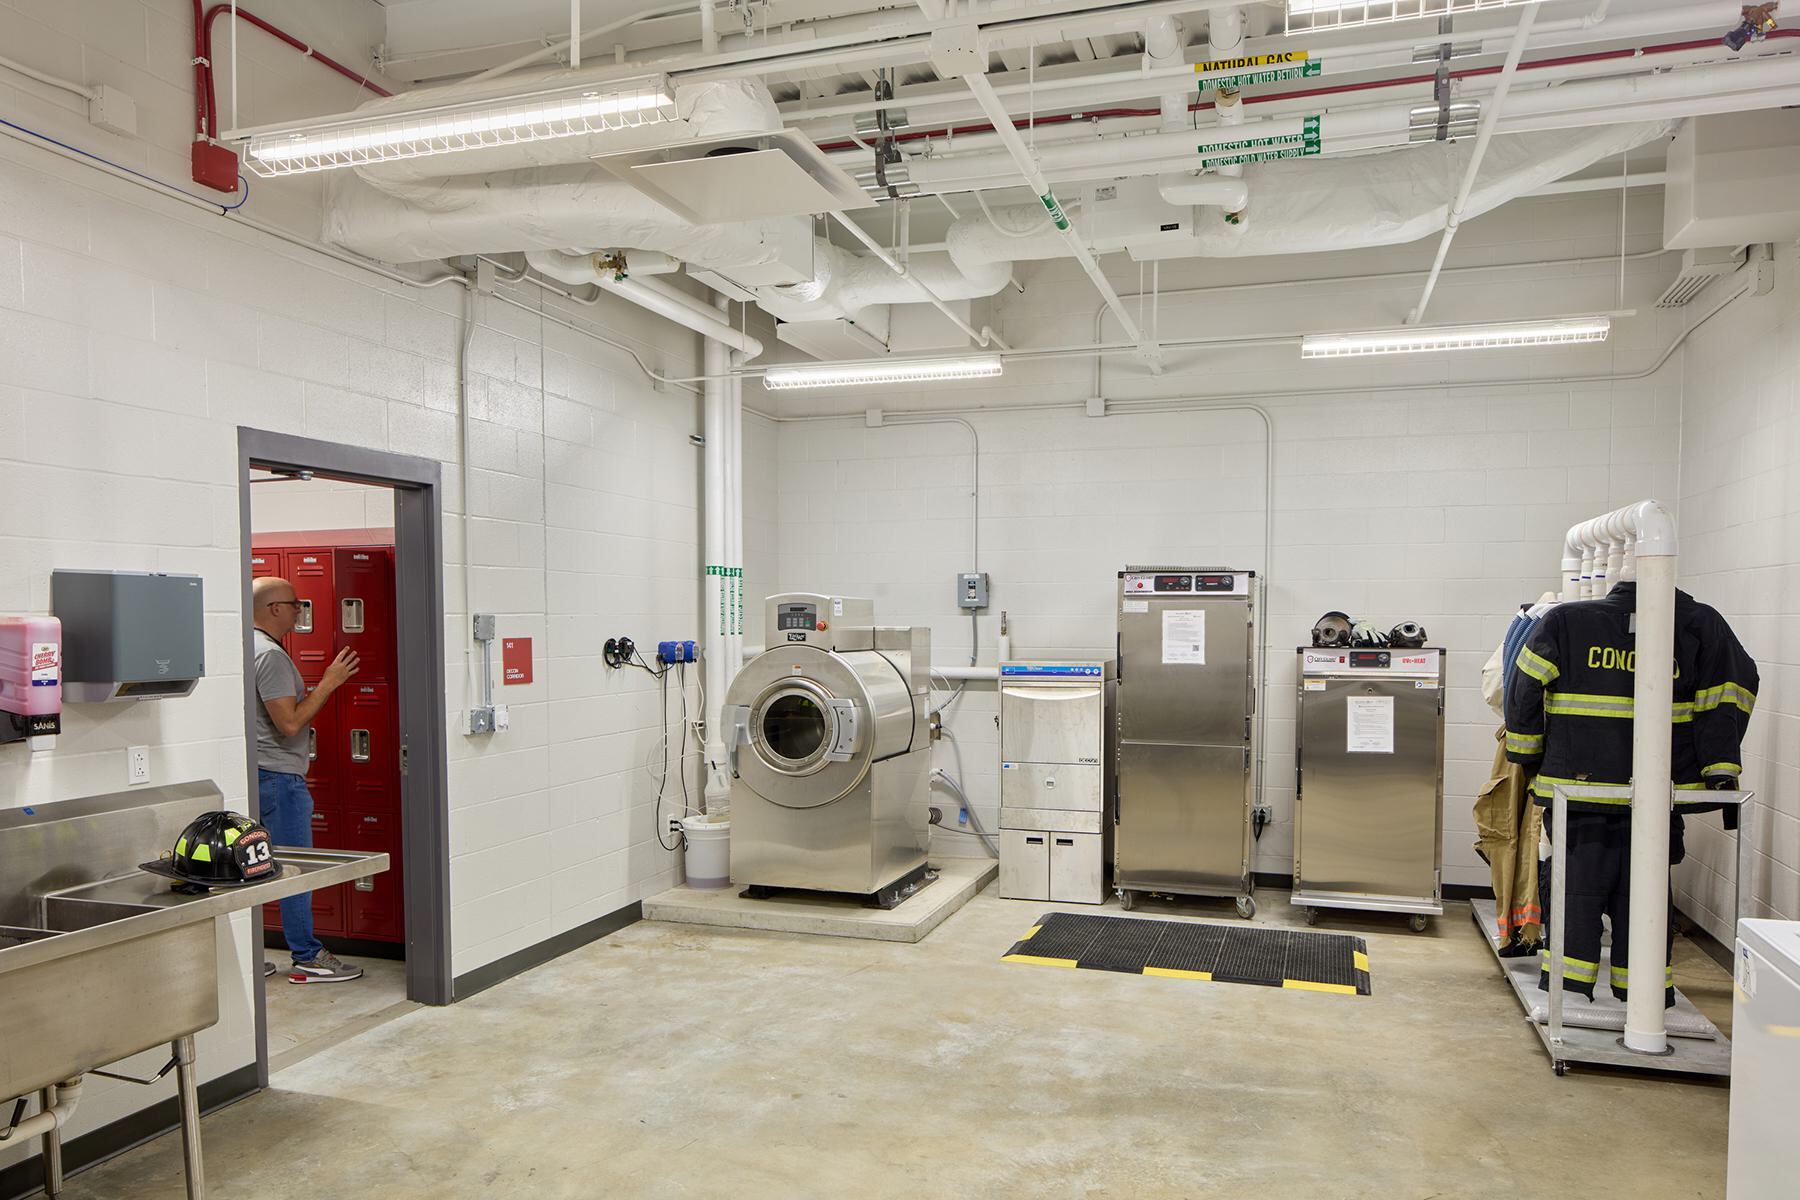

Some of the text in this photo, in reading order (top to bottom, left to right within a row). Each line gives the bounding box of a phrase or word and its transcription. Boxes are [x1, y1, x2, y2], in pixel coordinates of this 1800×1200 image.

[1202, 67, 1304, 91] DOMESTIC HOT WATER RETURN
[34, 650, 56, 660] CHERRY
[240, 831, 268, 845] CONCORD
[246, 841, 272, 865] 13
